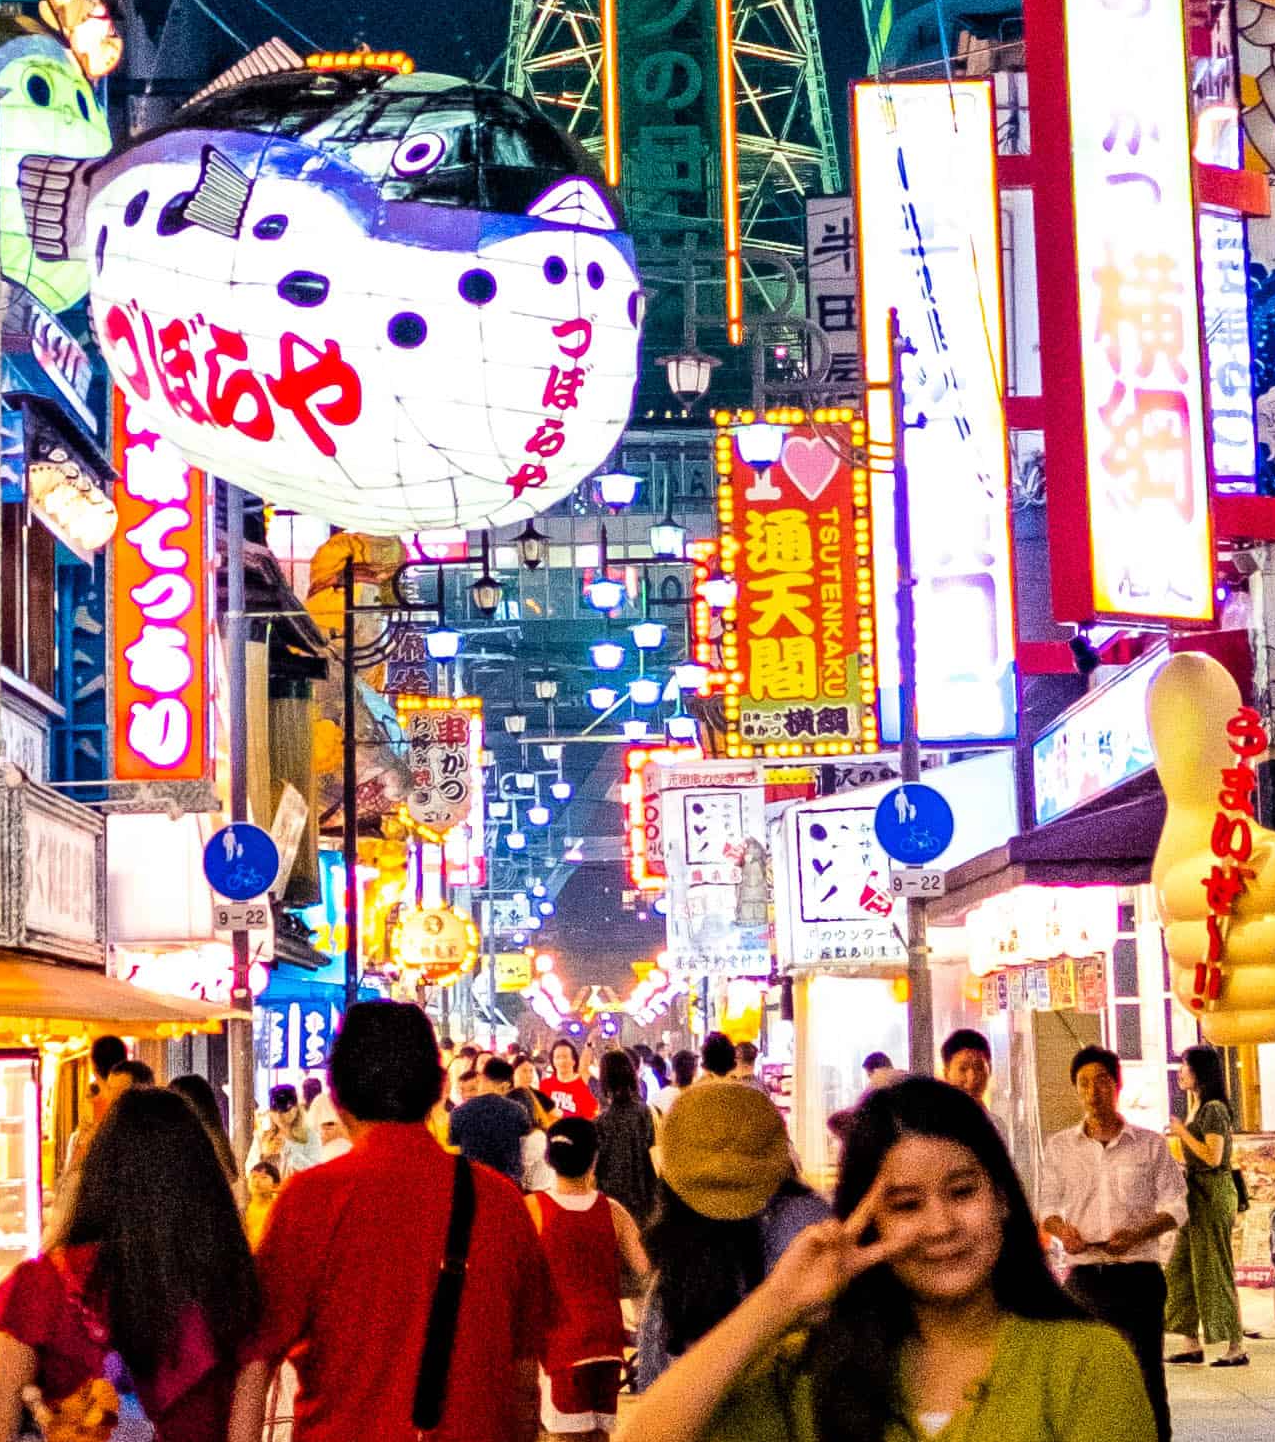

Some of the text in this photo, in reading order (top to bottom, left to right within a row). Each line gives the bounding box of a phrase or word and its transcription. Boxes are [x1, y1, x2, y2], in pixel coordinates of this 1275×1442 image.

[505, 312, 599, 499] づぼらや
[124, 398, 194, 772] 物てっちり
[745, 508, 819, 702] 通天閣
[817, 506, 848, 697] TSUTENKAKU
[435, 715, 470, 802] 串かつ
[218, 909, 265, 927] 9-22
